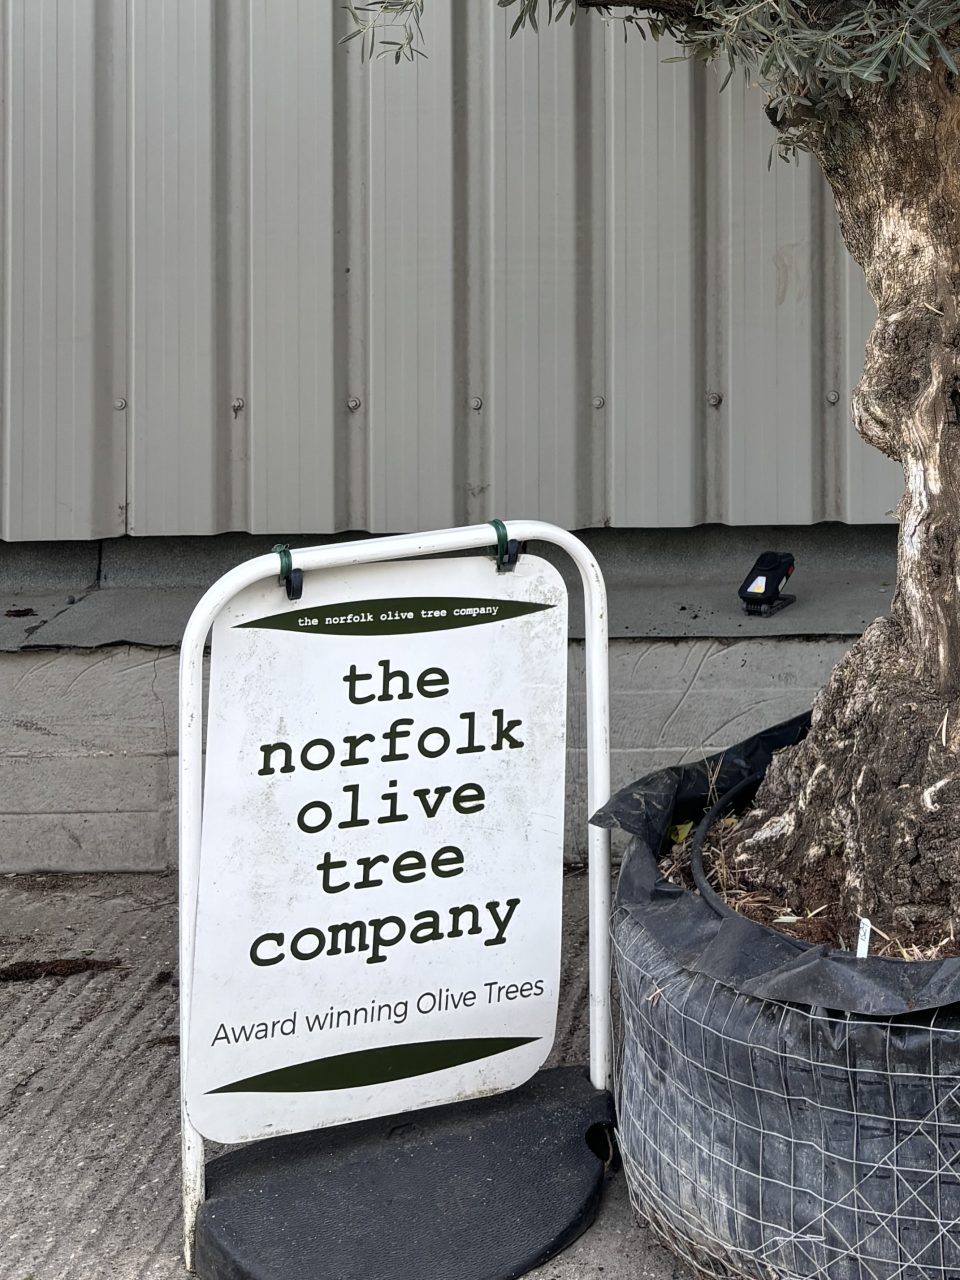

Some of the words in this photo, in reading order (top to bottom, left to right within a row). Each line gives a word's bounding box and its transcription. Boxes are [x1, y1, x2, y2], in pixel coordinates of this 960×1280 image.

[298, 616, 319, 627] the
[325, 612, 374, 625] norfolk
[380, 610, 414, 621] olive
[421, 608, 447, 618] tree
[453, 605, 499, 618] company
[343, 659, 450, 705] the
[257, 708, 525, 776] norfolk
[296, 780, 486, 834] olive
[316, 845, 465, 894] tree
[249, 897, 521, 967] company
[211, 1011, 297, 1047] Award
[305, 1000, 409, 1032] winning
[416, 988, 477, 1016] Olive
[483, 976, 545, 1004] Trees
